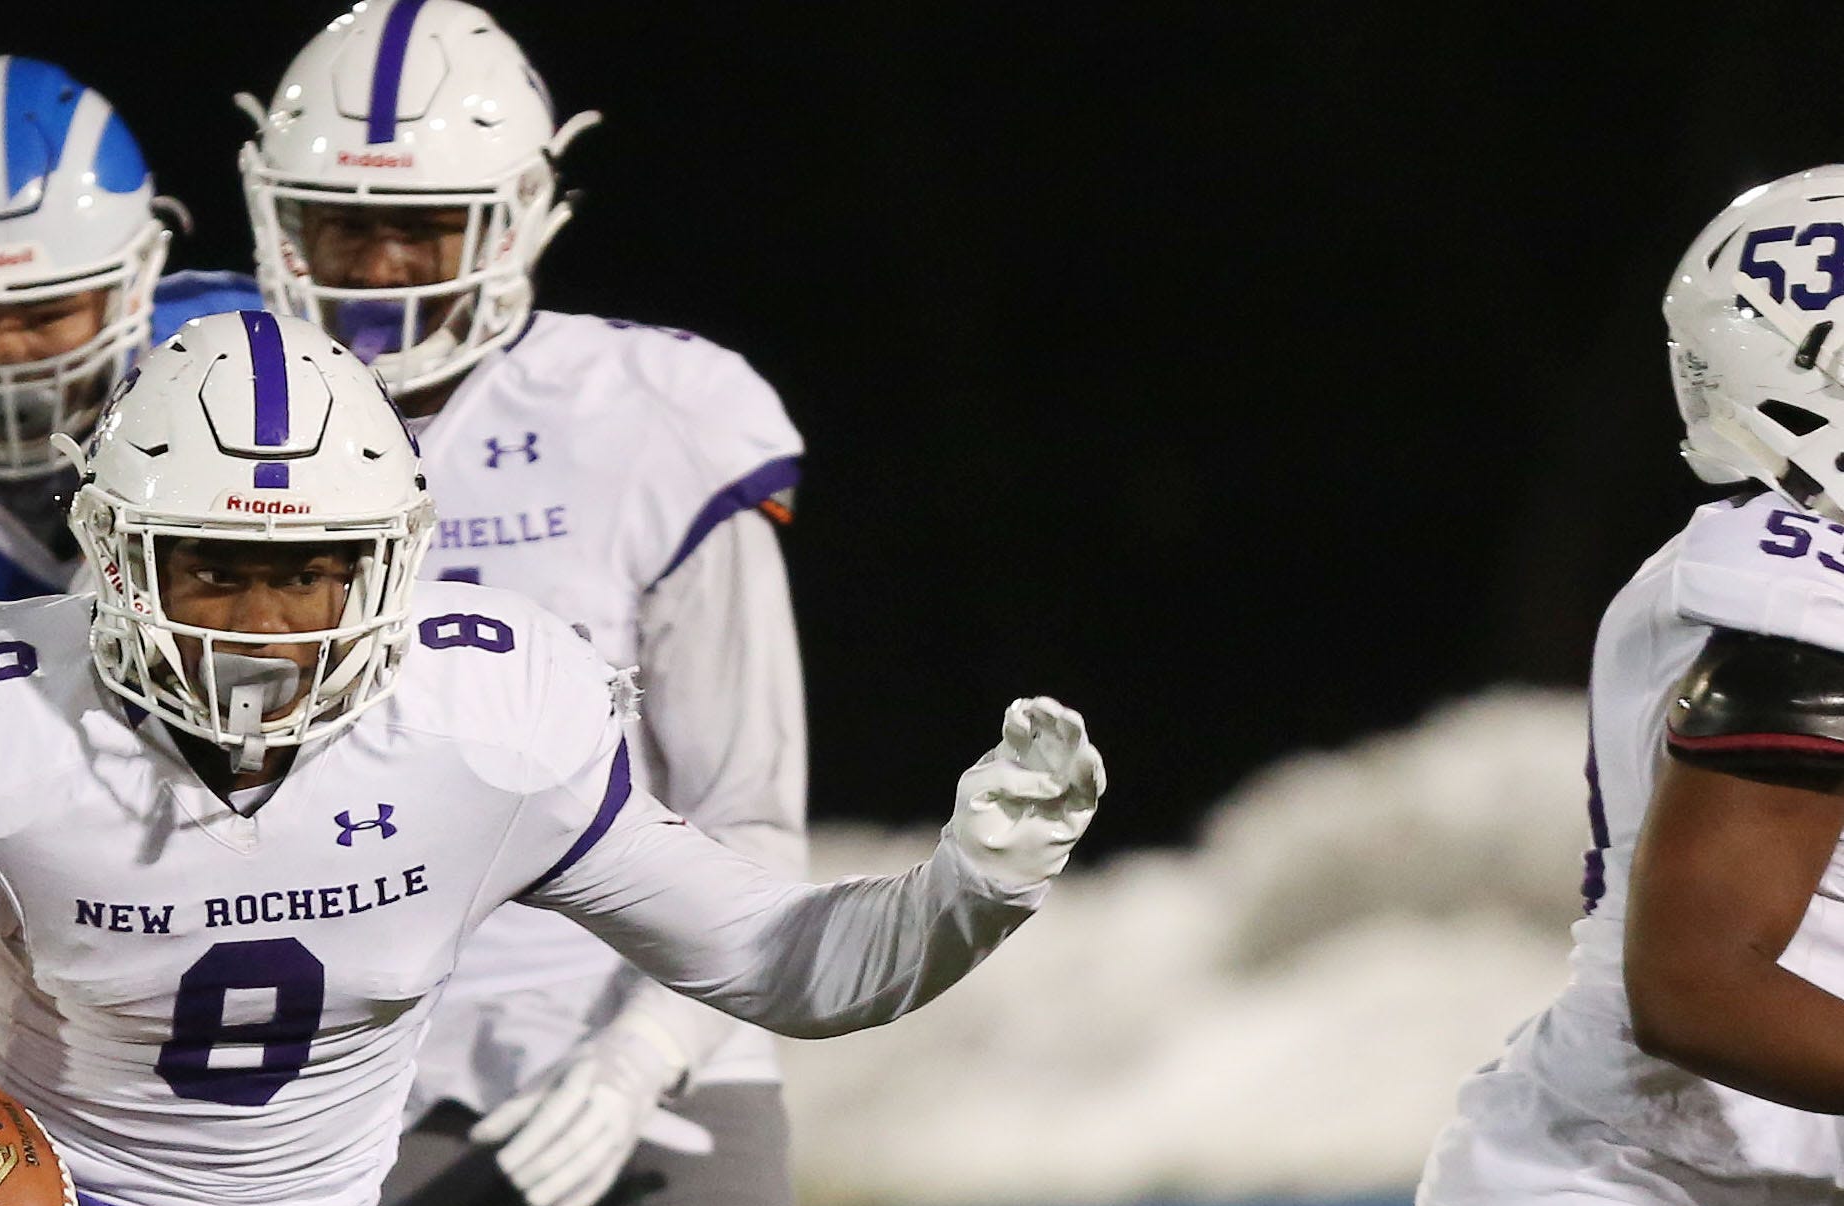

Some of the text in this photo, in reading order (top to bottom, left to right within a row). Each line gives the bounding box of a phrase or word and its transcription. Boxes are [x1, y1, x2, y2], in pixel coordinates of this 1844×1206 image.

[337, 150, 413, 168] Riddell
[1735, 222, 1844, 319] 53
[427, 505, 568, 550] HELLE
[418, 613, 516, 654] 8
[75, 864, 430, 934] NEW ROCHELLE
[153, 936, 326, 1107] 8
